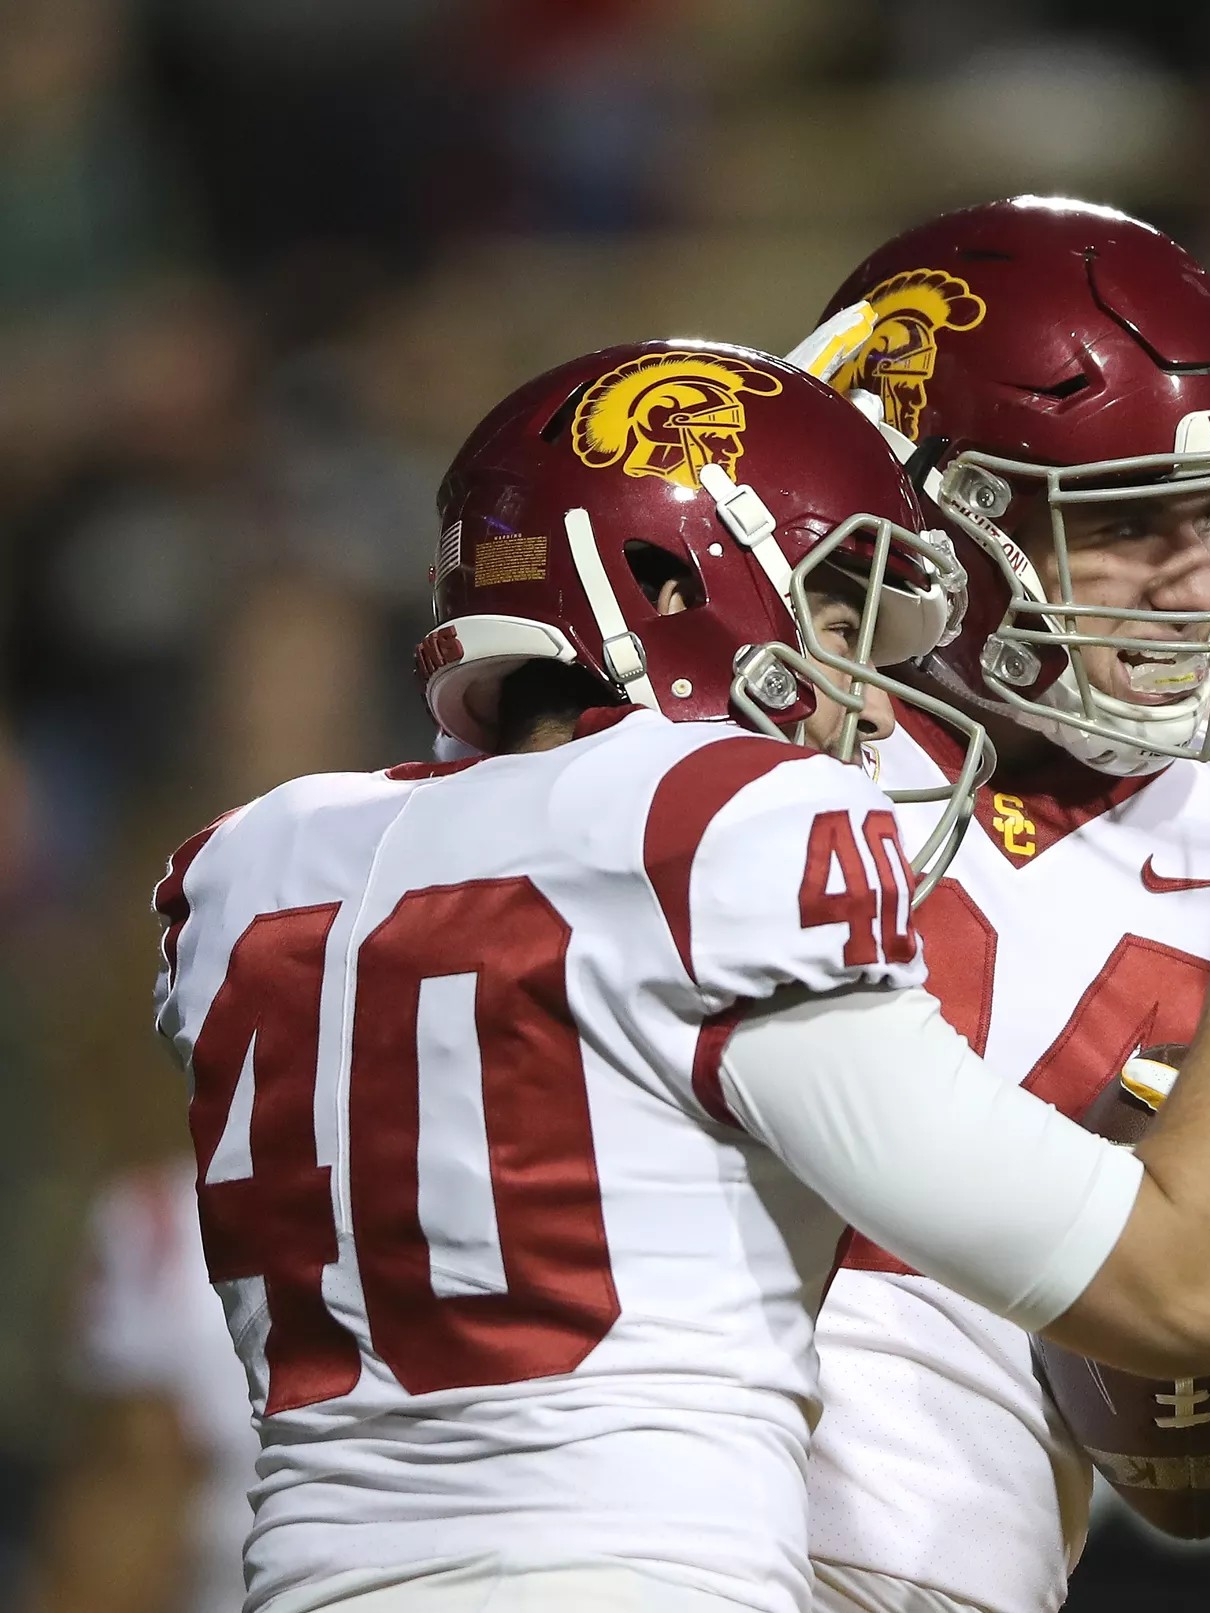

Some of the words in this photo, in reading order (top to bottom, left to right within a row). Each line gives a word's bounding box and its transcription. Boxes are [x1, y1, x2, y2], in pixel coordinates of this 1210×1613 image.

[799, 809, 917, 967] 40
[993, 792, 1036, 857] SC
[189, 875, 622, 1416] 40
